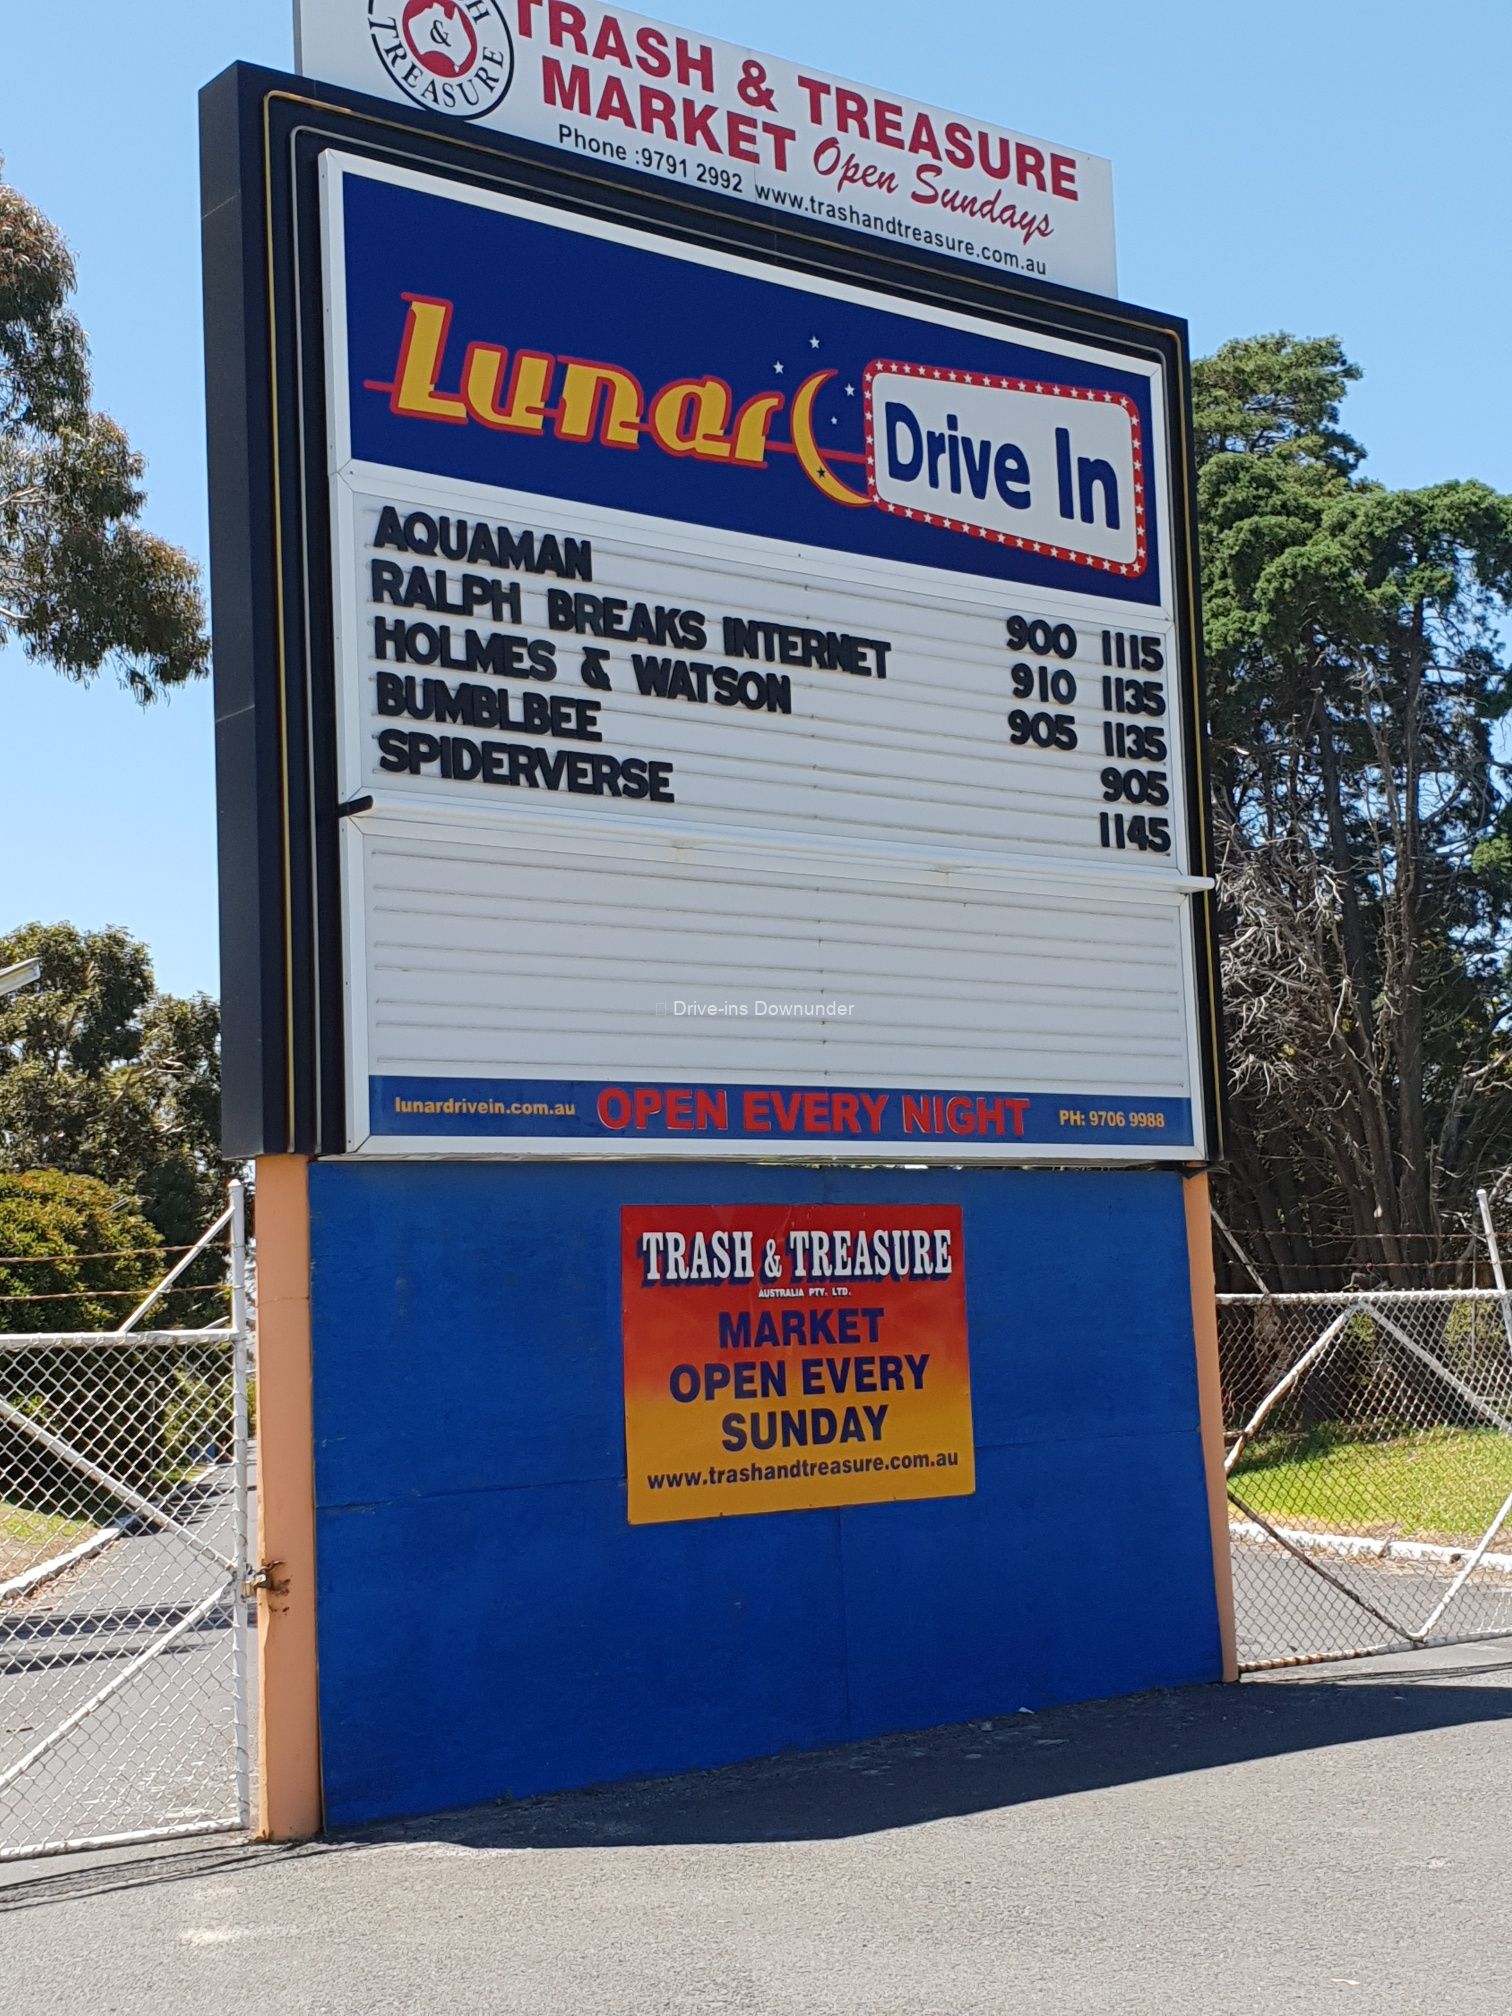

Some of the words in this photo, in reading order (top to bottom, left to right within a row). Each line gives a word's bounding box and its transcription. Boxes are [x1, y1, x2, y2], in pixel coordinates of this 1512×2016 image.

[430, 20, 451, 47] &
[368, 16, 504, 108] TREASURE
[517, 0, 714, 93] TRASH
[737, 59, 778, 113] &
[797, 75, 1078, 201] TREASURE
[542, 55, 796, 172] MARKET
[558, 124, 627, 160] Phone
[696, 163, 743, 193] 2992
[813, 137, 899, 192] Open
[911, 164, 1054, 245] Sundays
[755, 184, 1047, 275] www.trashandtreasure.com.au
[366, 292, 784, 468] Lunar
[884, 402, 1031, 510] Drive
[1055, 427, 1120, 530] In
[374, 506, 592, 581] AQUAMAN
[371, 559, 521, 624] RALPH
[548, 588, 706, 650] BREAKS
[722, 616, 891, 678] INTERNET
[1006, 615, 1077, 659] 900
[1102, 630, 1163, 671] 1115
[374, 616, 556, 681] HOLMES
[581, 646, 612, 691] &
[632, 654, 791, 714] WATSON
[1011, 663, 1076, 704] 910
[1103, 676, 1166, 717] 1135
[376, 671, 602, 742] BUMBLBEE
[1008, 709, 1078, 750] 905
[1104, 721, 1167, 762] 1135
[378, 729, 674, 803] SPIDERVERSE
[1101, 767, 1169, 806] 905
[1100, 812, 1171, 852] 1145
[395, 1097, 575, 1116] lunardrivein.com.au
[597, 1088, 728, 1131] OPEN
[743, 1091, 889, 1133] EVERY
[902, 1095, 1029, 1136] NIGHT
[1058, 1109, 1085, 1126] PH:
[1089, 1111, 1125, 1128] 9706
[1129, 1113, 1165, 1129] 9988
[641, 1231, 754, 1281] TRASH
[764, 1238, 782, 1279] &
[790, 1229, 952, 1277] TREASURE
[758, 1287, 804, 1298] AUSTRALIA
[832, 1286, 851, 1296] LTD.
[718, 1308, 884, 1349] MARKET
[669, 1360, 786, 1403] OPEN
[802, 1354, 930, 1395] EVERY
[721, 1405, 888, 1451] SUNDAY
[647, 1452, 958, 1489] www.trashandtreasure.com.au
